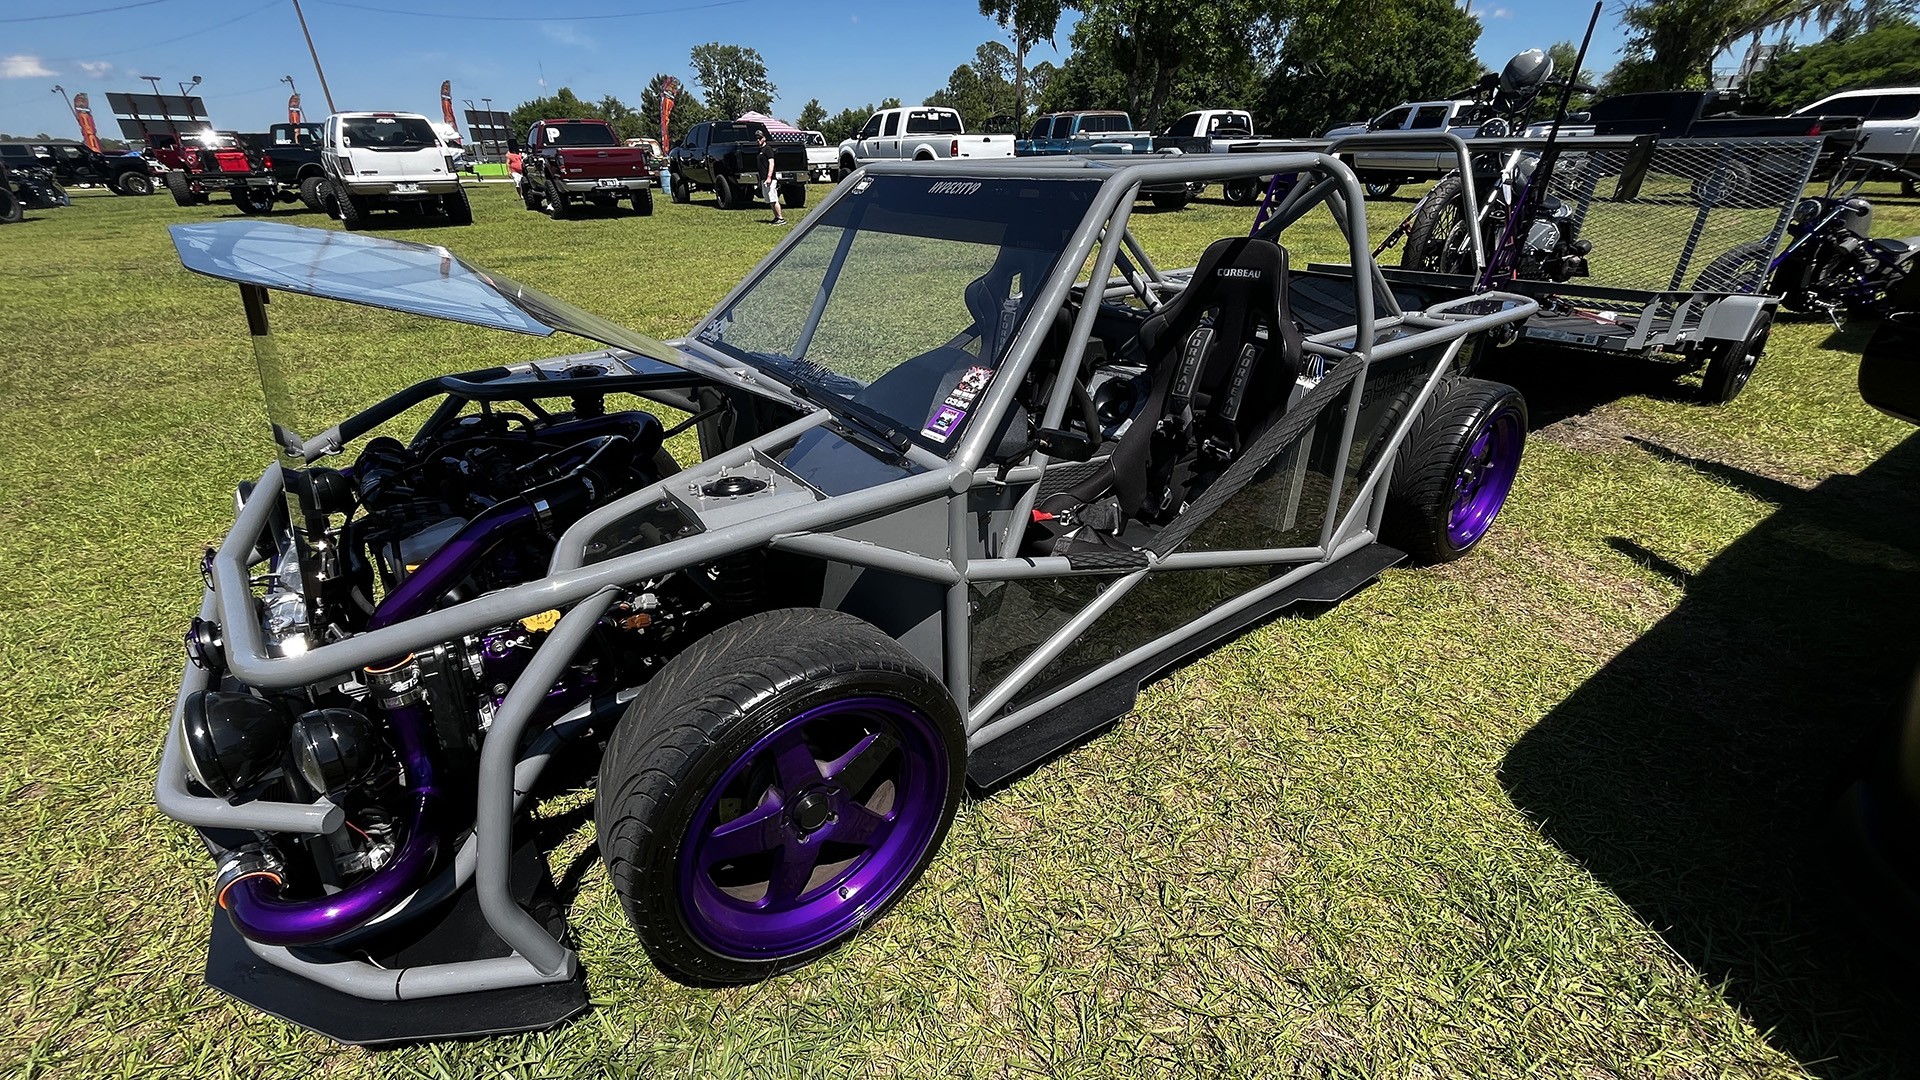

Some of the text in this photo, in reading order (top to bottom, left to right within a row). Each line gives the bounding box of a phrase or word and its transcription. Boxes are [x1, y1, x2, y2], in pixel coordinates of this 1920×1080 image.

[546, 127, 560, 142] P
[928, 181, 982, 195] HYPECITY9
[1217, 268, 1262, 279] CORBEAU
[1177, 331, 1206, 393] CORBEAU
[1223, 348, 1256, 415] CORBEAU
